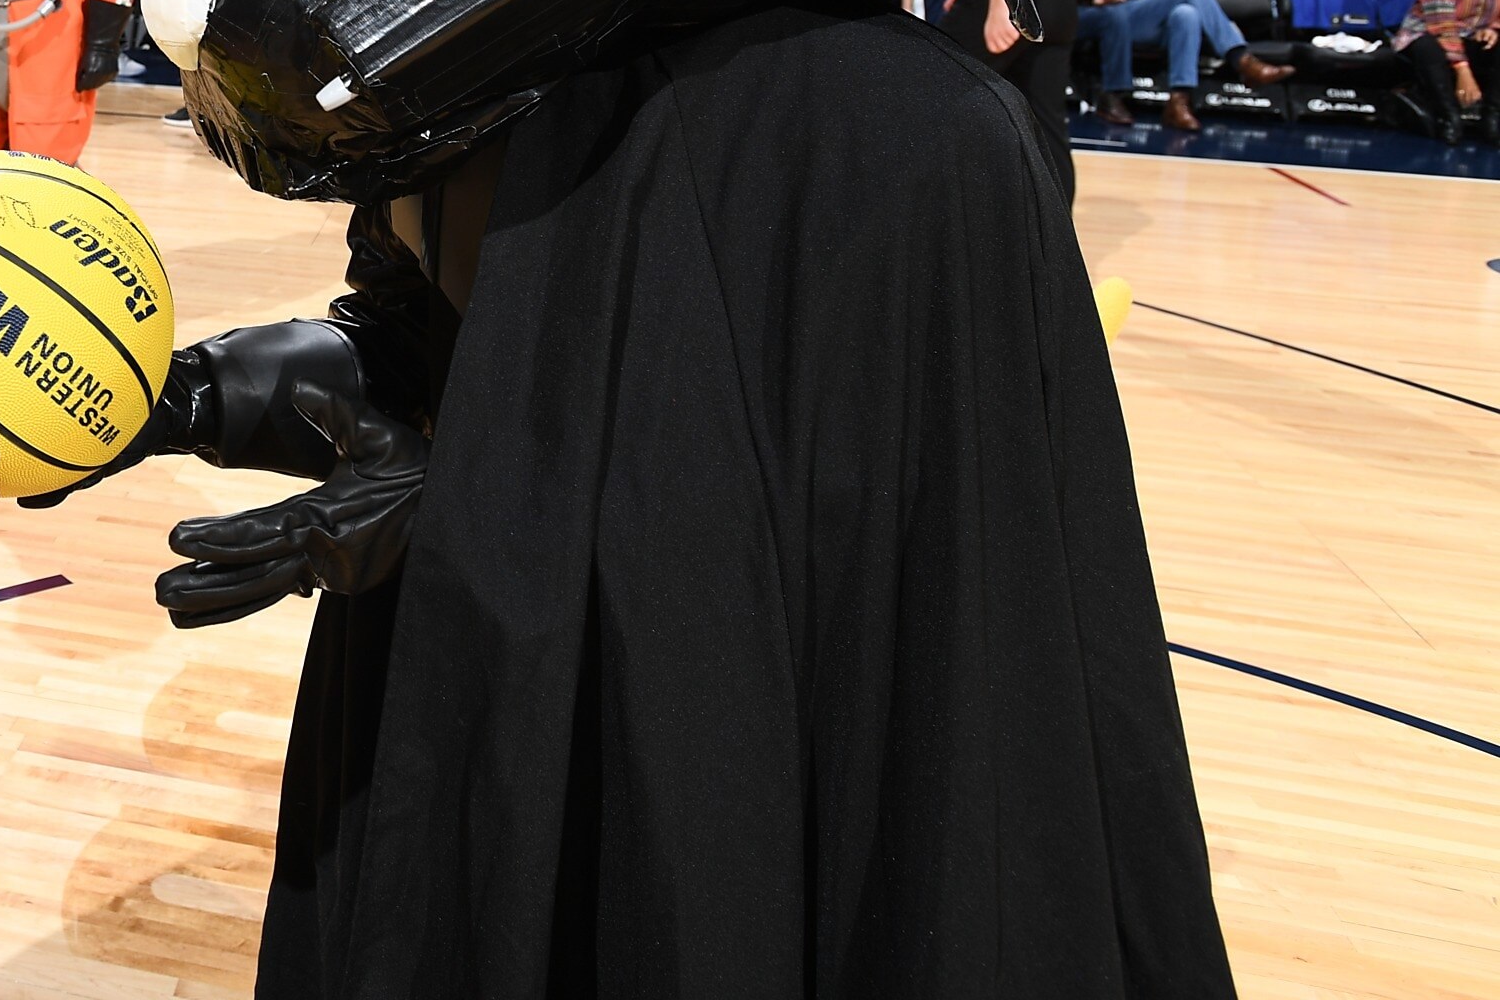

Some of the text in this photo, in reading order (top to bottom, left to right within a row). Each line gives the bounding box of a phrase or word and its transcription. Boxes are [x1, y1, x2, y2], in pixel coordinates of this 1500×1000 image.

[67, 214, 105, 239] WEIGHT
[114, 244, 132, 263] SIZE
[49, 220, 158, 322] Baden
[14, 351, 120, 446] WESTERN
[30, 333, 114, 411] UNION
